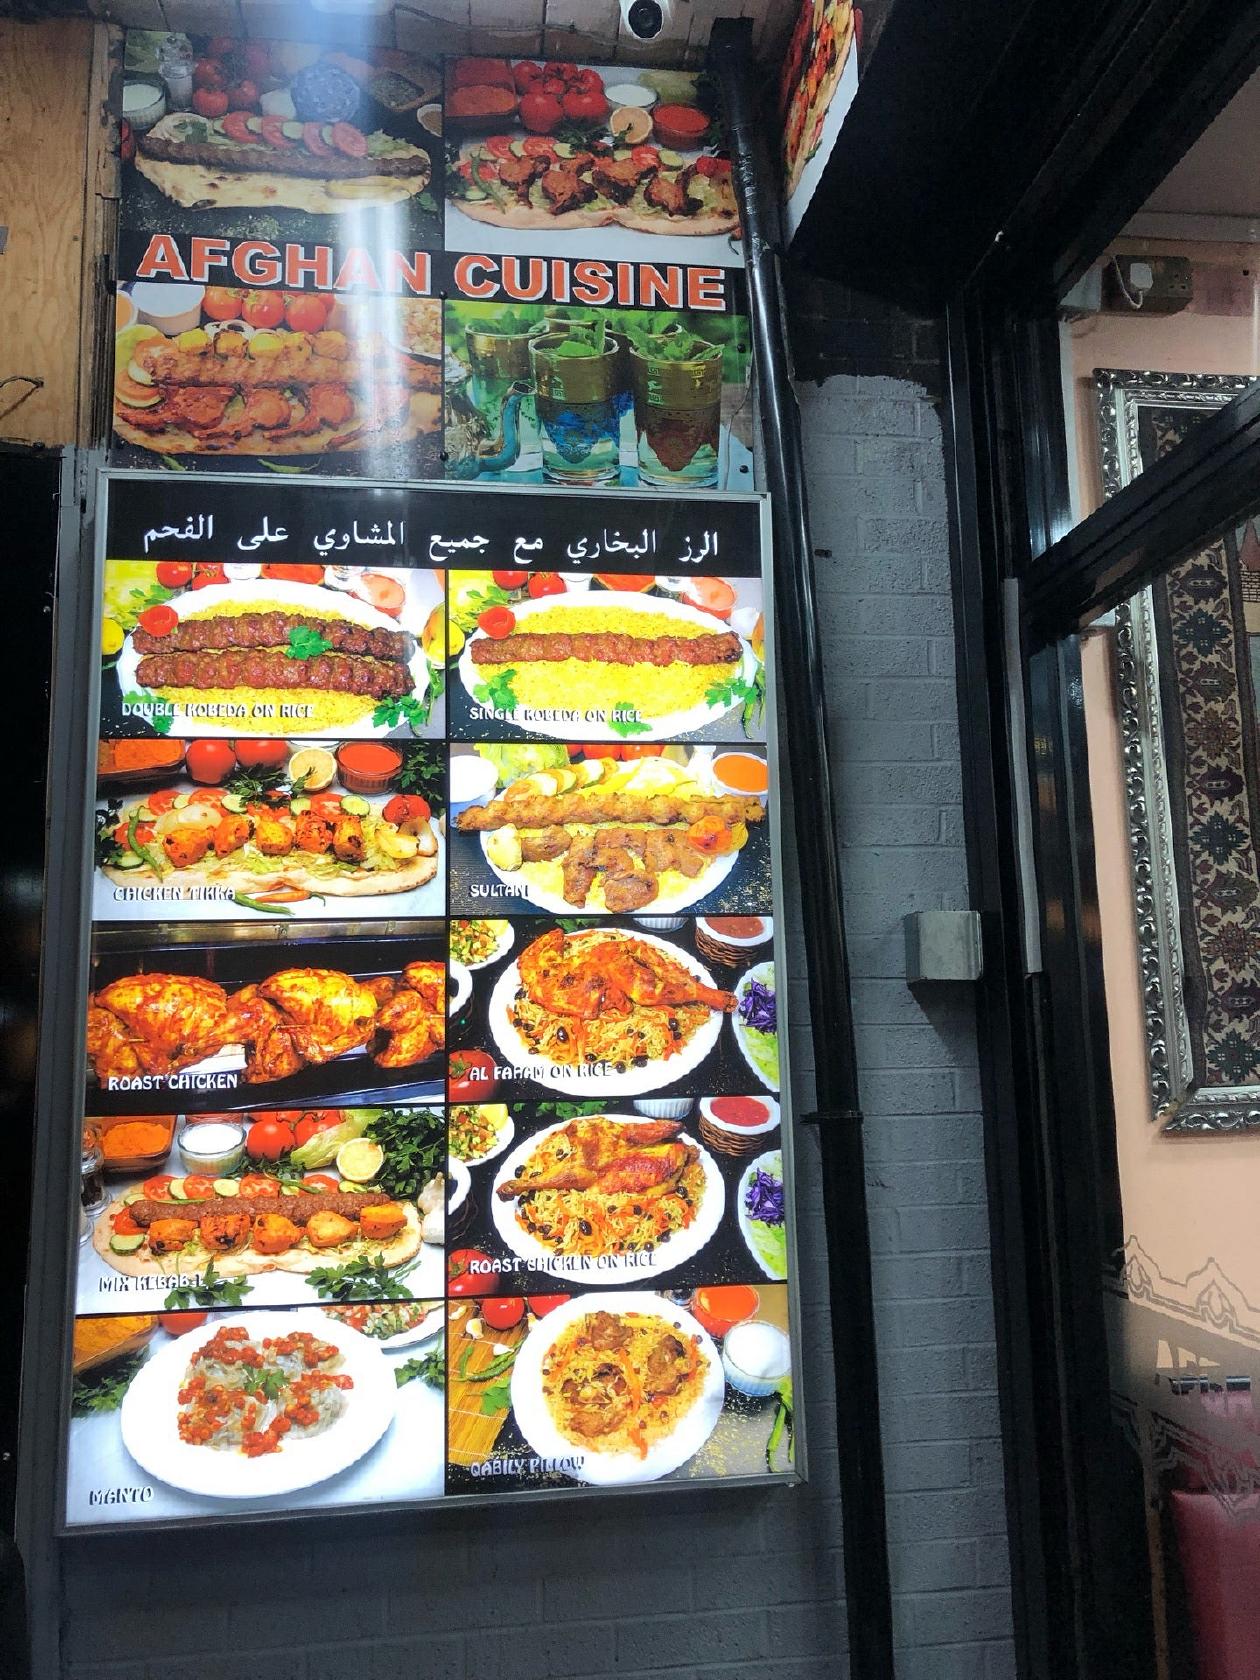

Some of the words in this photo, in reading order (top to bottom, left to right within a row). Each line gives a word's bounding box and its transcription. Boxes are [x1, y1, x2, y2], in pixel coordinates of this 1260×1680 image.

[135, 233, 431, 295] AFGHAN
[454, 254, 727, 311] CUISINE
[143, 515, 214, 555] الفحم
[236, 516, 290, 552] على
[313, 521, 405, 559] المشاوي
[428, 532, 490, 563] جميع
[512, 535, 544, 564] مع
[566, 529, 656, 563] البخاري
[678, 531, 719, 563] الرز
[122, 703, 180, 717] DOUBLE
[185, 703, 247, 718] KOBEDA
[251, 704, 275, 718] ON
[279, 704, 316, 718] RICE
[469, 707, 519, 721] SINGLE
[585, 710, 607, 723] ON
[611, 709, 643, 723] RICE
[113, 886, 181, 901] CHICKEN
[188, 886, 236, 901] TIKKA
[469, 884, 530, 898] SULTANI
[108, 1074, 163, 1091] ROAST
[168, 1073, 238, 1089] CHICKEN
[469, 1066, 489, 1081] AL
[550, 1064, 573, 1079] ON
[577, 1062, 613, 1077] RICE
[470, 1258, 522, 1274] ROAST
[527, 1256, 592, 1272] CHICKEN
[597, 1254, 620, 1270] ON
[624, 1252, 658, 1268] RICE
[99, 1277, 129, 1293] MIX
[470, 1458, 524, 1477] QABILY
[89, 1486, 154, 1506] MANTO
